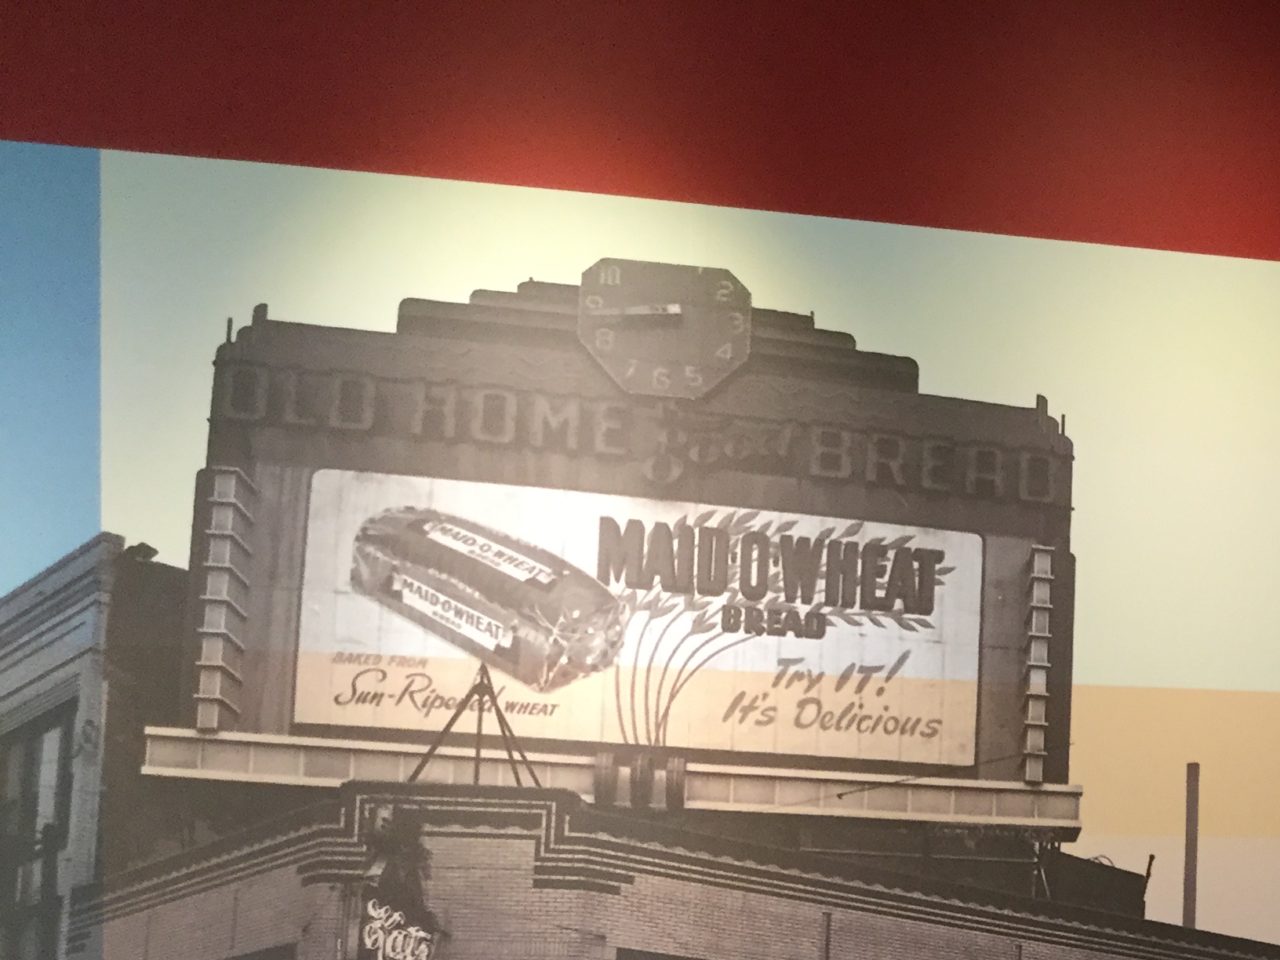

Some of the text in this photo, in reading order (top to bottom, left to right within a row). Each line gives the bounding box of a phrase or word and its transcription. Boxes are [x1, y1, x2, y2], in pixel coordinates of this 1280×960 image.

[716, 280, 734, 302] 2
[728, 311, 744, 335] 3
[596, 328, 614, 350] 8
[715, 342, 733, 360] 4
[652, 367, 671, 390] 6
[685, 365, 703, 386] 5
[220, 361, 374, 432] OLD
[411, 388, 633, 457] HOME
[811, 427, 1056, 502] BREAD
[721, 604, 826, 640] BREAD
[387, 655, 429, 669] FROM
[333, 667, 560, 718] Sun-Ripeed WHEAT
[792, 699, 943, 740] Delicious
